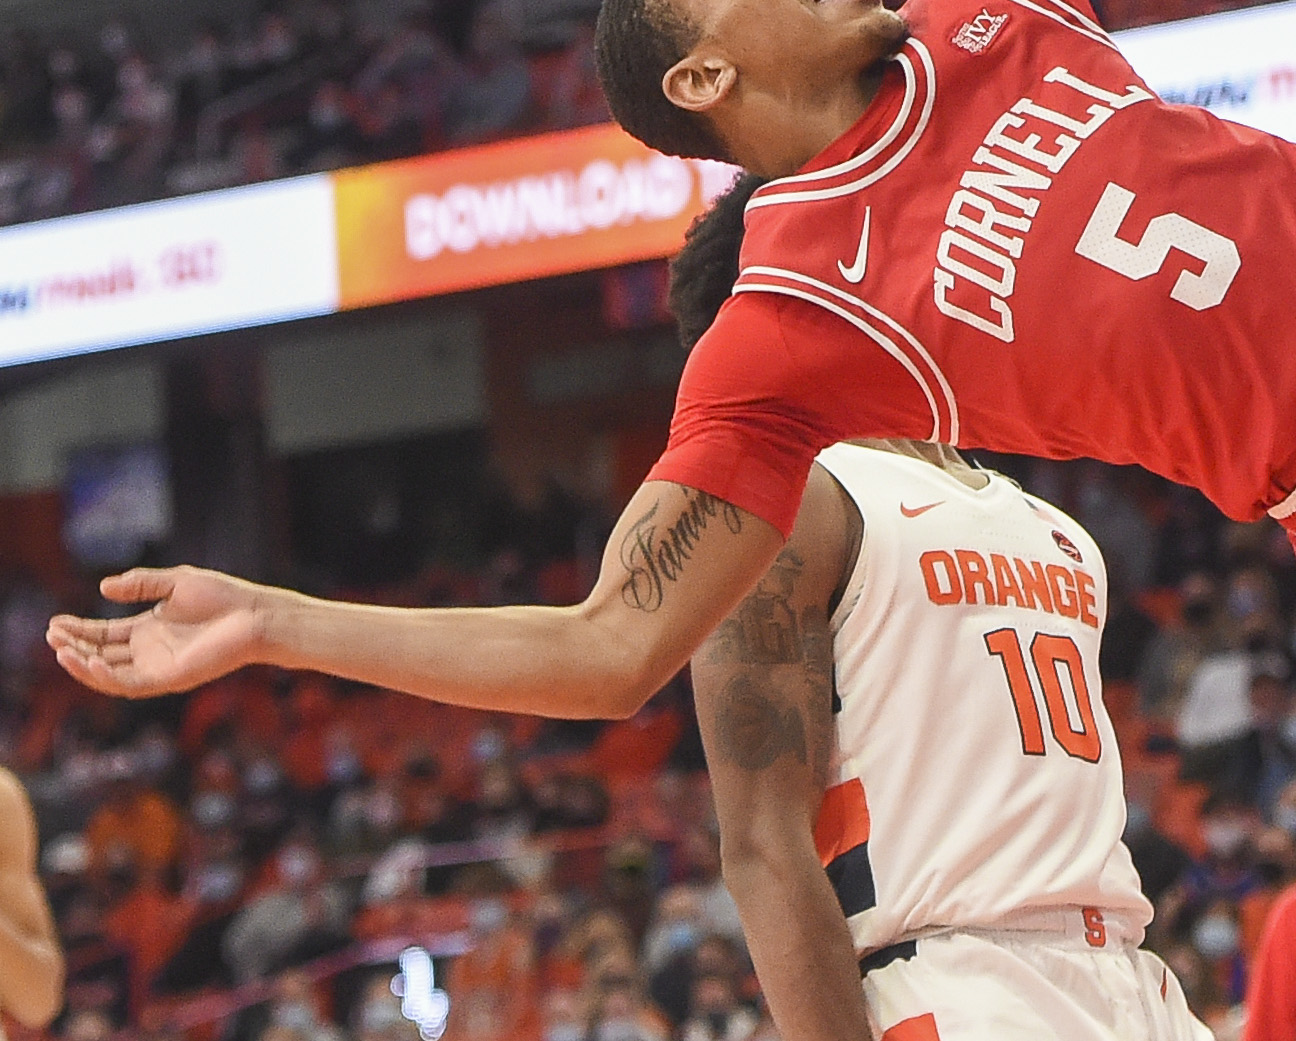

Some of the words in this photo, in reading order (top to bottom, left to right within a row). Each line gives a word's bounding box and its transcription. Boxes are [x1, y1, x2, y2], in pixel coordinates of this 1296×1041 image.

[964, 8, 996, 43] IVY
[979, 14, 1006, 48] LEAGUE
[403, 155, 694, 260] DOWNLOAD
[933, 65, 1155, 344] CORNELL
[1074, 180, 1242, 312] 5
[919, 549, 1099, 629] ORANGE
[983, 627, 1102, 764] 10
[1081, 906, 1107, 949] S
